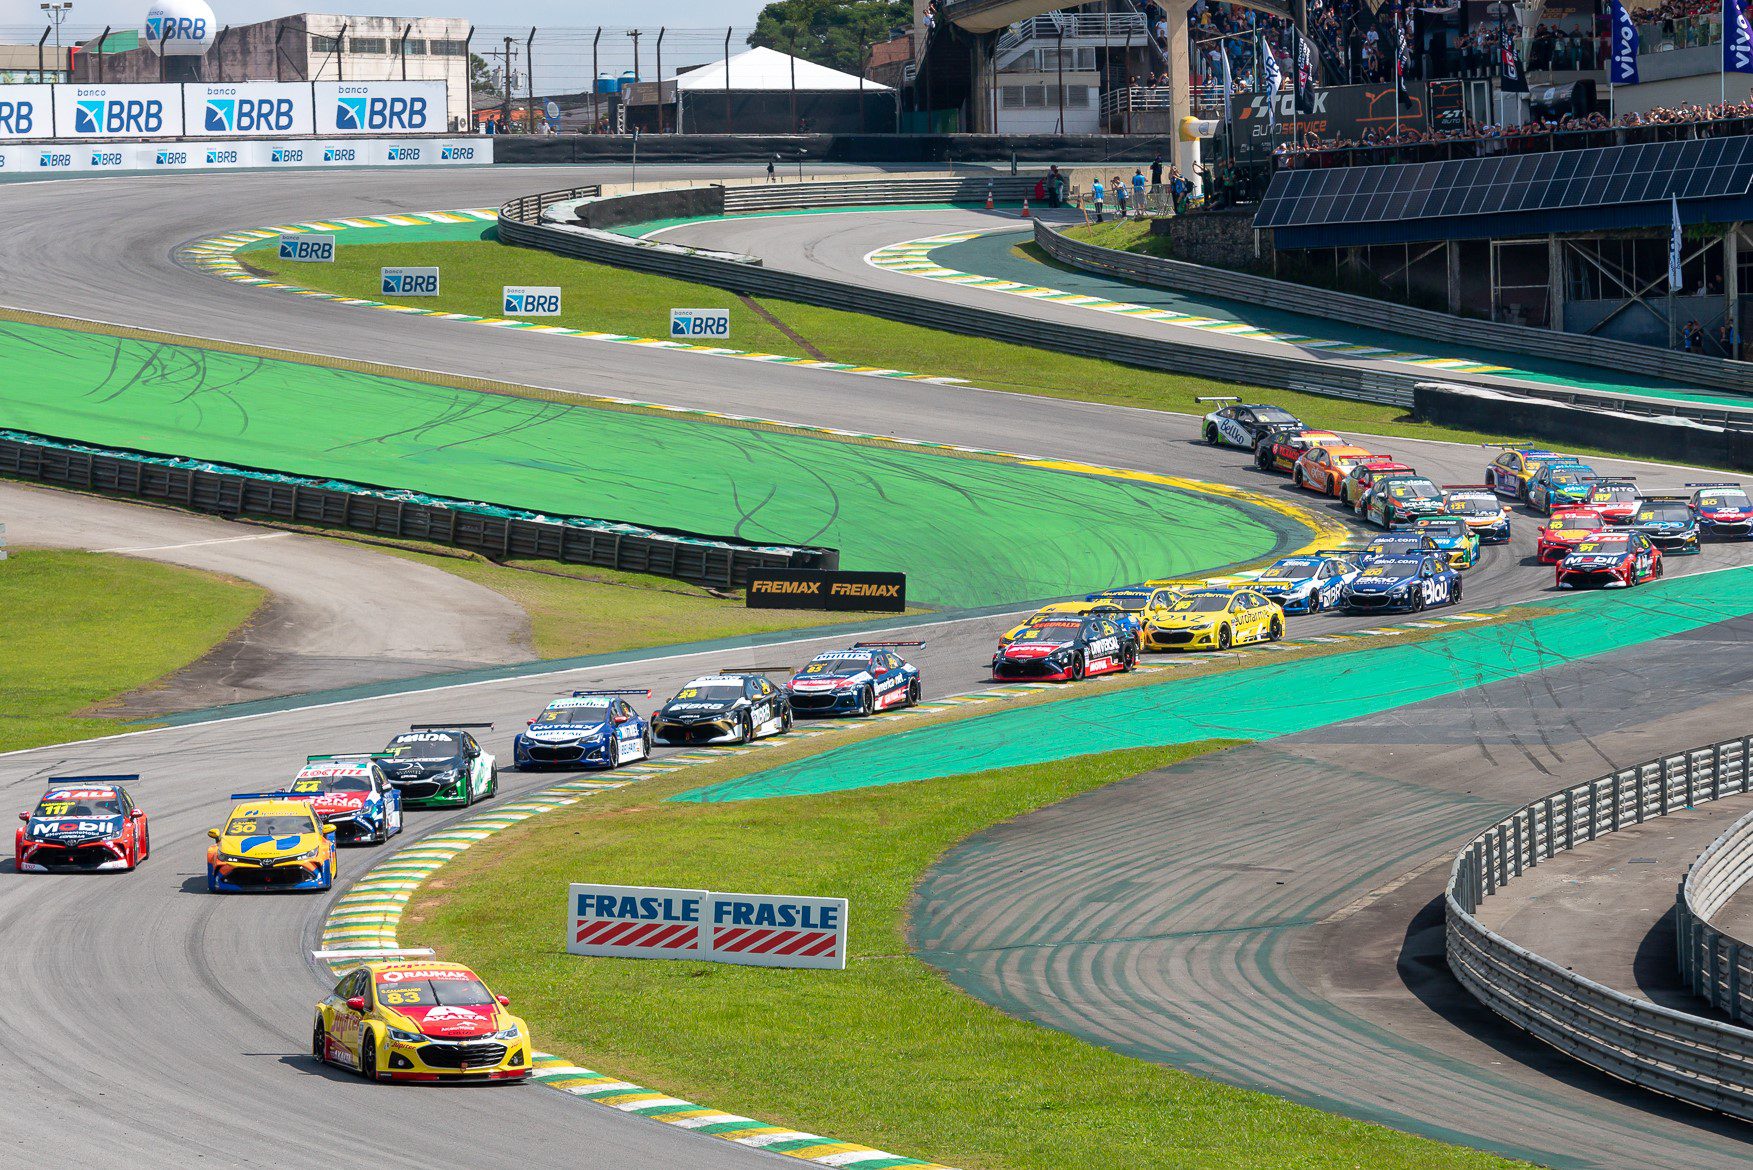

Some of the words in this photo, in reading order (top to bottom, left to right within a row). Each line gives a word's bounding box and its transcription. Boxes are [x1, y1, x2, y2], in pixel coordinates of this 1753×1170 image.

[162, 18, 206, 40] BRB
[1730, 14, 1751, 69] vivo
[1615, 26, 1635, 79] vivo
[77, 89, 106, 97] banco
[207, 87, 236, 96] banco
[338, 86, 368, 94] banco
[107, 100, 162, 133] BRB
[236, 98, 293, 131] BRB
[368, 97, 427, 130] BRB
[102, 153, 122, 165] BRB
[167, 152, 187, 164] BRB
[217, 151, 237, 163] BRB
[283, 150, 303, 162] BRB
[334, 149, 355, 161] BRB
[399, 148, 420, 160] BRB
[452, 147, 474, 160] BRB
[51, 154, 71, 166] BRB
[298, 242, 332, 259] BRB
[402, 275, 437, 292] BRB
[524, 295, 559, 312] BRB
[692, 317, 728, 335] BRB
[1565, 556, 1618, 564] Mobil
[752, 580, 821, 594] FREMAX
[831, 583, 900, 597] FREMAX
[300, 769, 365, 777] LOCTITE
[45, 805, 68, 815] 111
[33, 821, 113, 836] Mobil
[230, 824, 257, 834] 30
[387, 992, 421, 1004] 83
[422, 1014, 488, 1022] AXALTA
